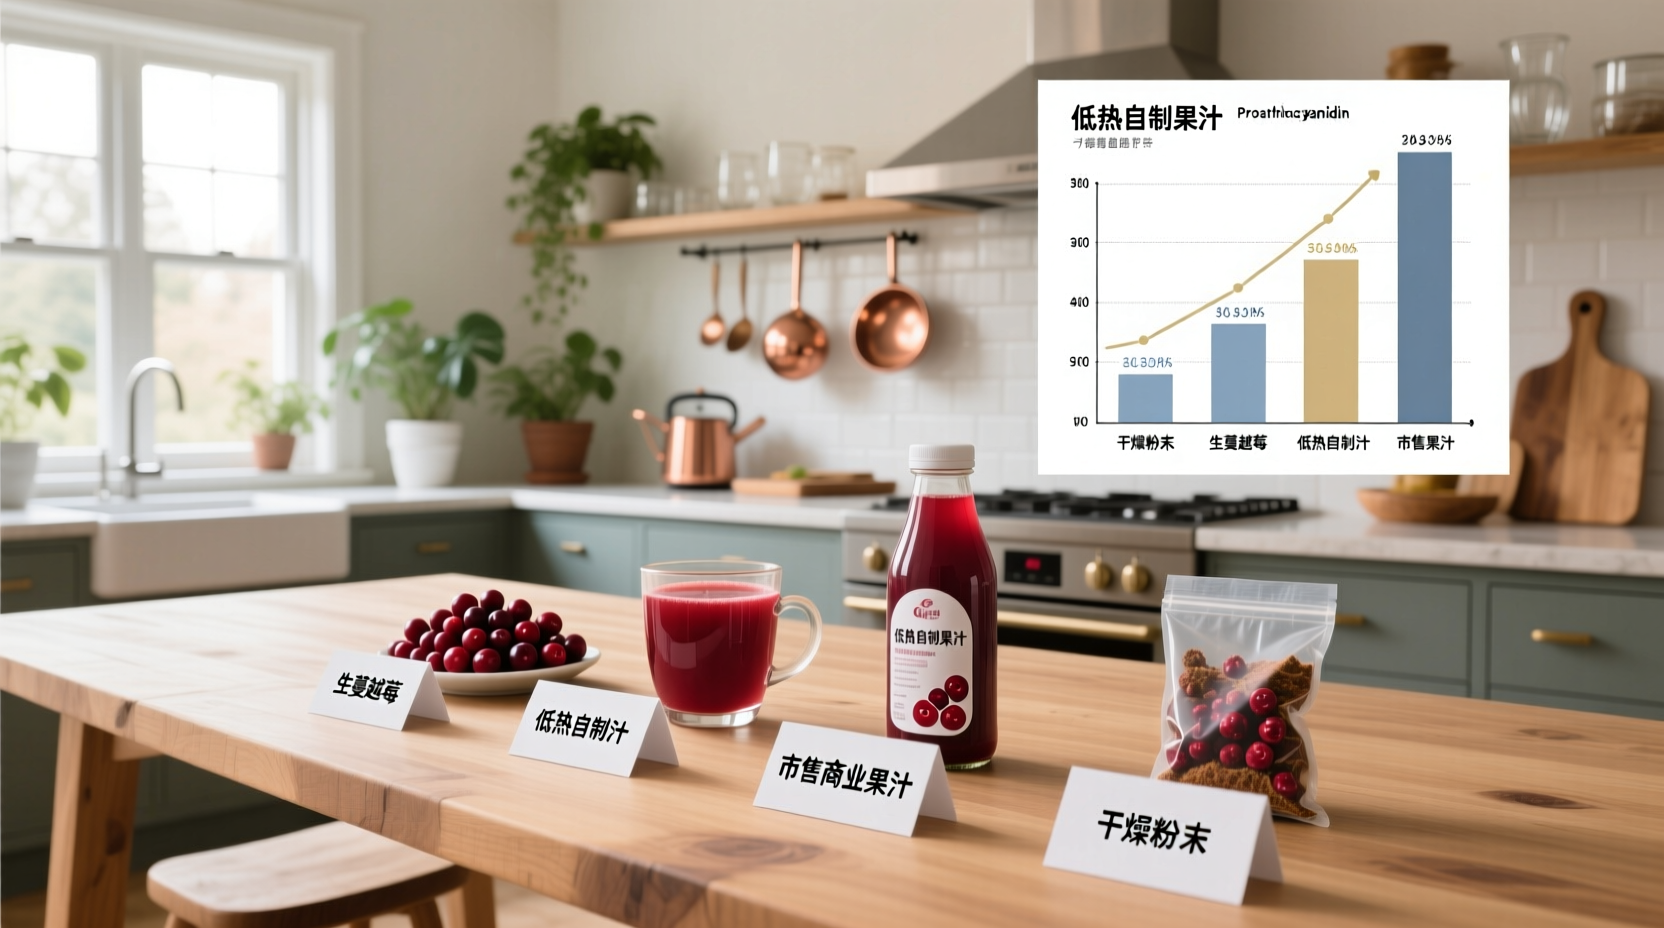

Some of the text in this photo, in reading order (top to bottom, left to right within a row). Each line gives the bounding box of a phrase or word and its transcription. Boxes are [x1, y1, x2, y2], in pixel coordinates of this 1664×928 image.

[535, 708, 629, 745] 低热自制汁
[778, 753, 914, 800] 市售商业果汁
[1097, 809, 1212, 855] 干燥粉末
